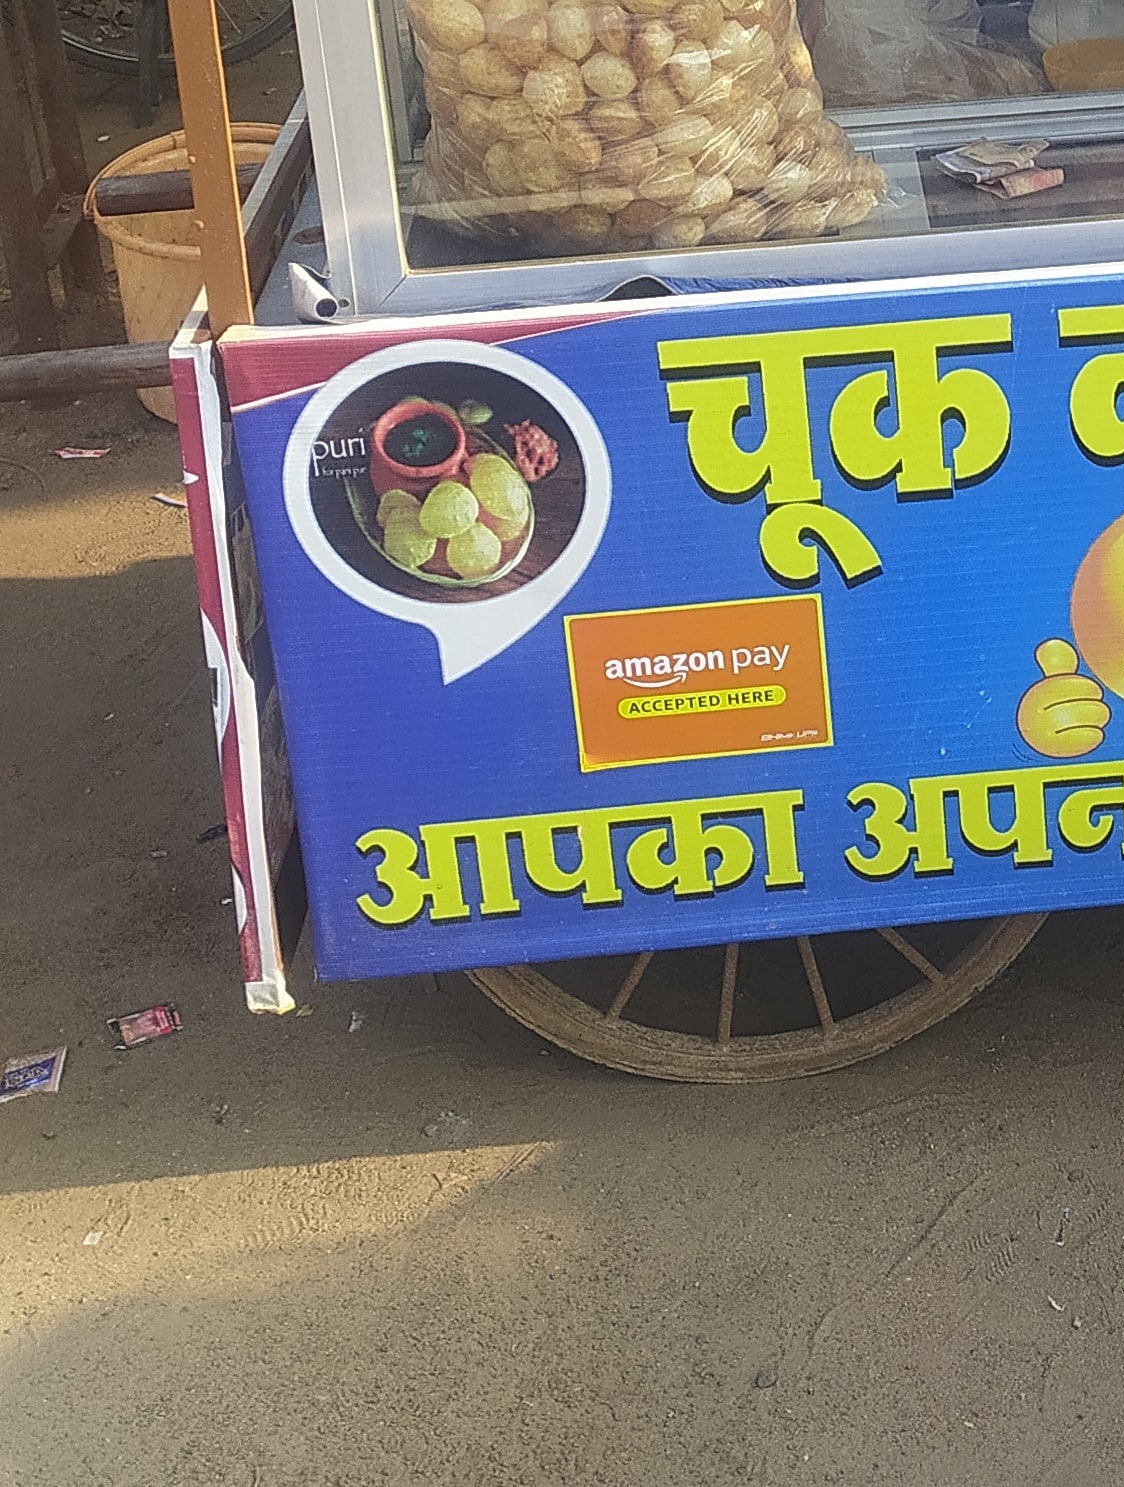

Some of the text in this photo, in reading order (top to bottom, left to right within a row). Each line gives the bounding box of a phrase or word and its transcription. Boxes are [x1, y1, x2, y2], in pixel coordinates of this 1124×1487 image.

[311, 427, 367, 477] puri
[658, 313, 1012, 588] चूक
[605, 644, 790, 684] amazon pay
[629, 689, 775, 715] ACCEPTED HERE
[354, 788, 804, 927] आपका
